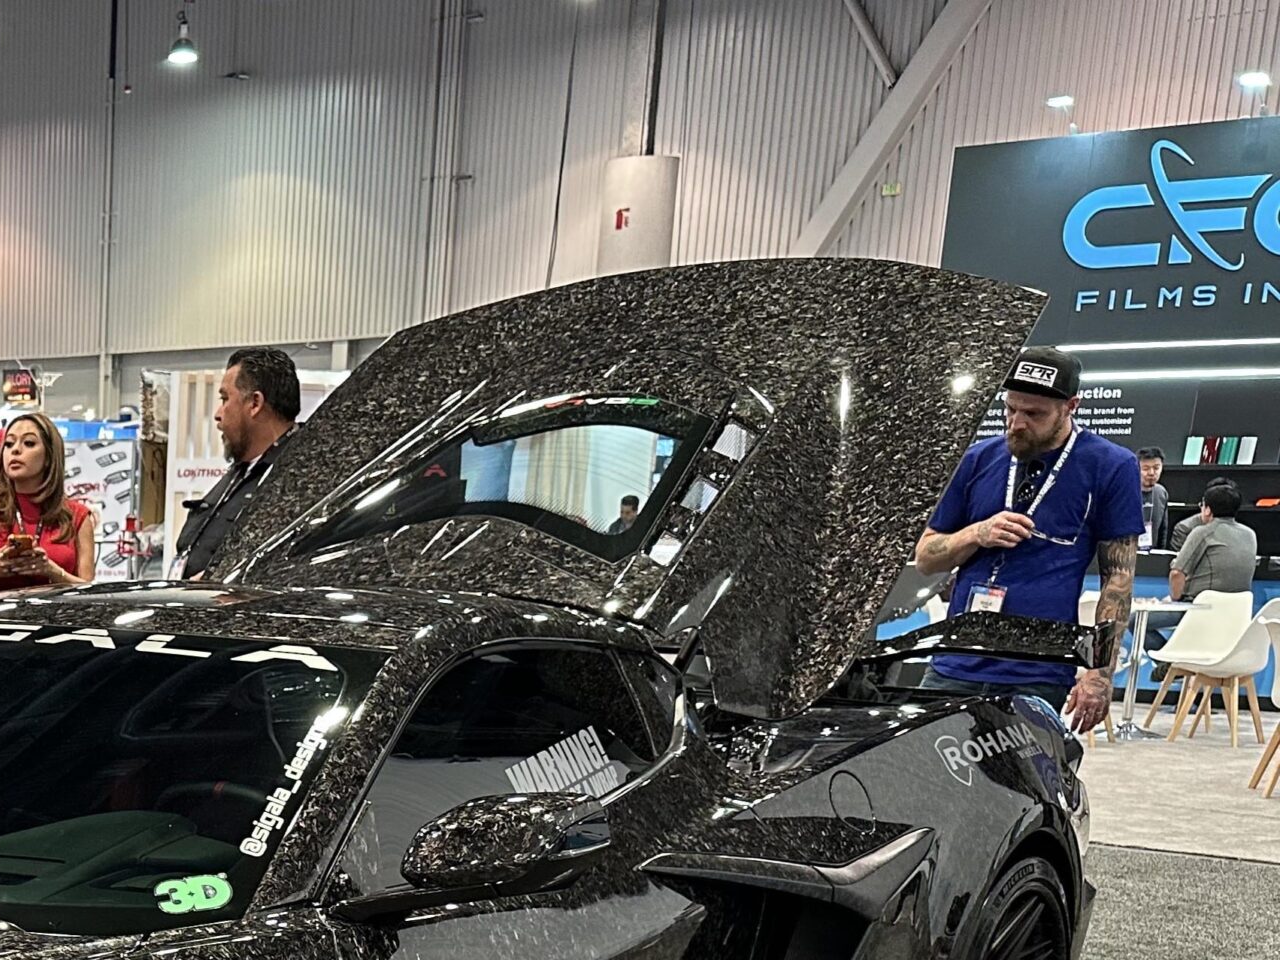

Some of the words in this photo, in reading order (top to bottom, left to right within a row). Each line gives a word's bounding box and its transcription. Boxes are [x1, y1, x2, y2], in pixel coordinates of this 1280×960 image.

[1075, 285, 1217, 312] FILMS
[1019, 363, 1056, 380] SPR
[1077, 387, 1122, 399] uction
[1093, 407, 1116, 415] brand
[1117, 407, 1135, 415] from
[504, 725, 610, 793] WARNING!
[943, 722, 1037, 771] ROHANA
[239, 710, 333, 858] @sigala_design
[589, 765, 618, 799] WRAP
[154, 875, 233, 914] 3D
